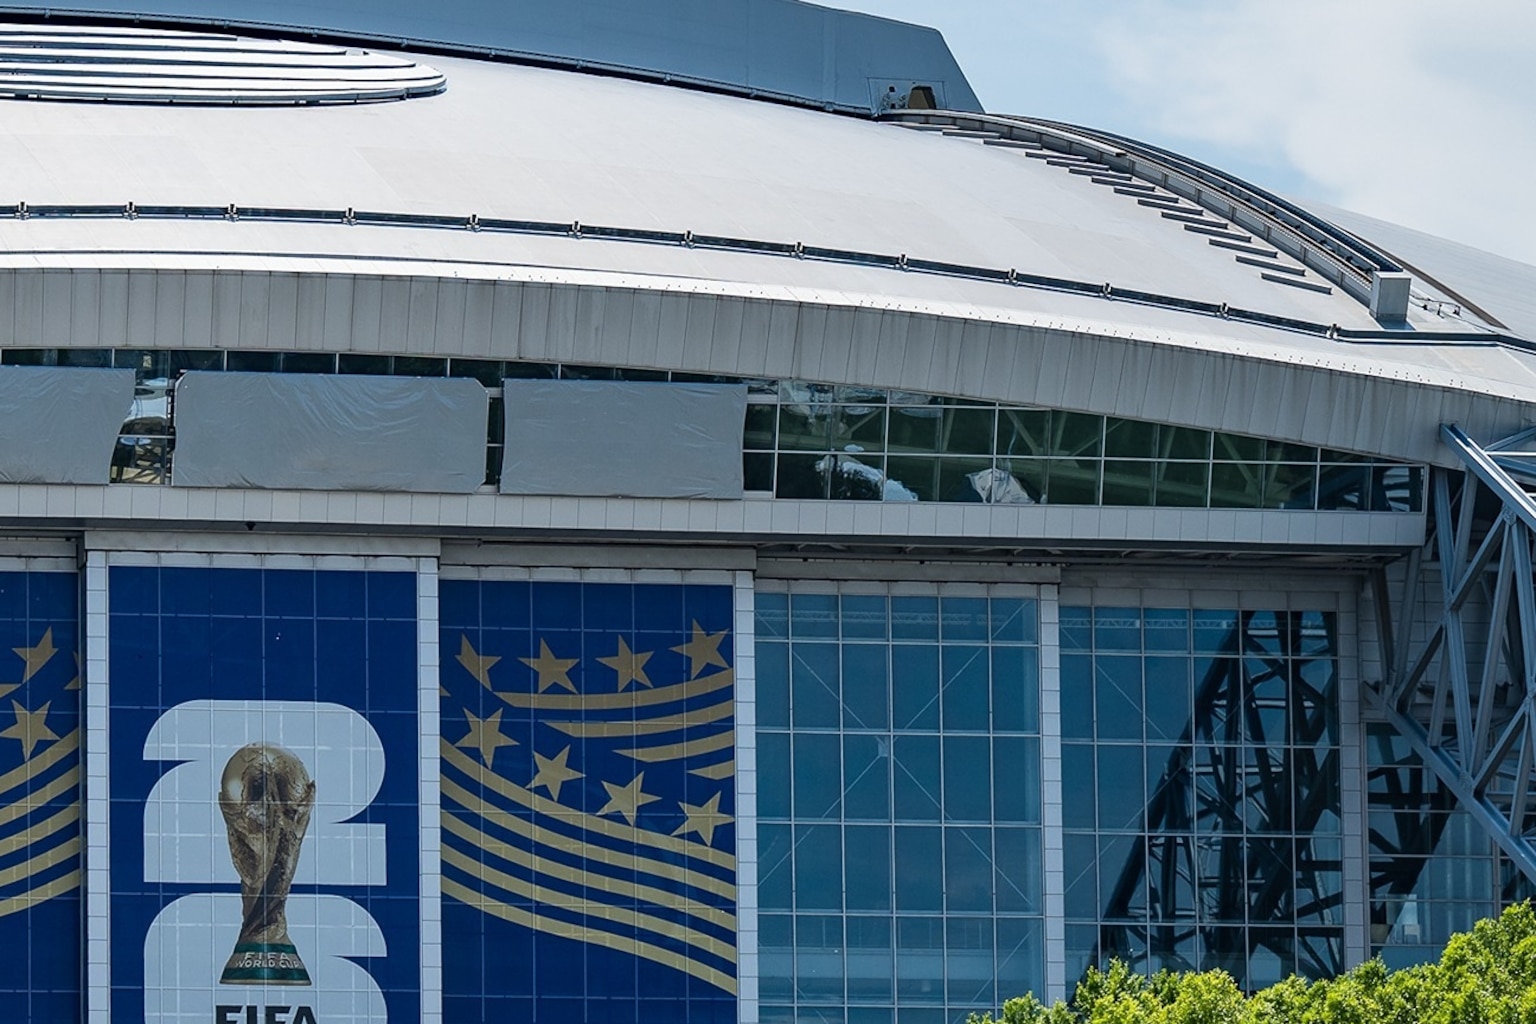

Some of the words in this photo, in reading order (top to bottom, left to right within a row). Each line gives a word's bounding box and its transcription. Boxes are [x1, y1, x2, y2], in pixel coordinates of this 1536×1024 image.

[244, 952, 290, 960] FIFA
[235, 960, 276, 968] WORLD
[279, 960, 301, 968] CUP
